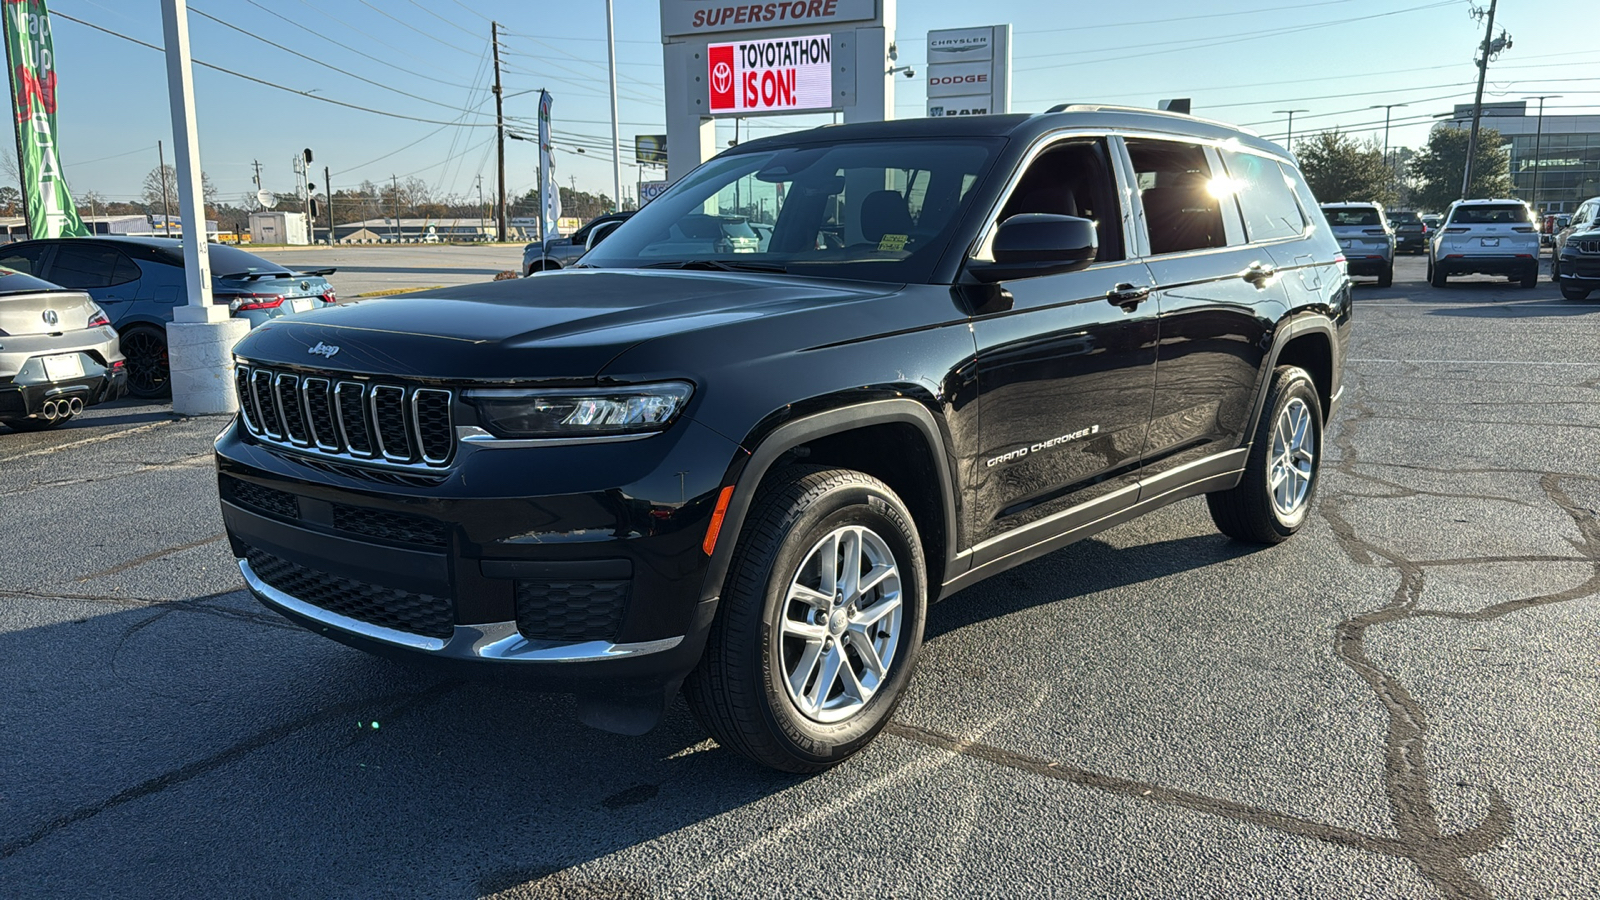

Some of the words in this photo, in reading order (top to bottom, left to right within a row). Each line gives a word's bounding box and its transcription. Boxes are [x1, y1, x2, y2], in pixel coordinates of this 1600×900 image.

[692, 0, 838, 28] SUPERSTORE
[739, 38, 830, 69] TOYOTATHON
[931, 37, 987, 46] CHRYSLER
[743, 71, 758, 108] IS
[761, 68, 796, 107] ON!
[930, 74, 988, 86] DODGE
[308, 341, 340, 358] Jeep
[986, 447, 1029, 468] GRAND
[1030, 427, 1090, 453] CHEROKEE
